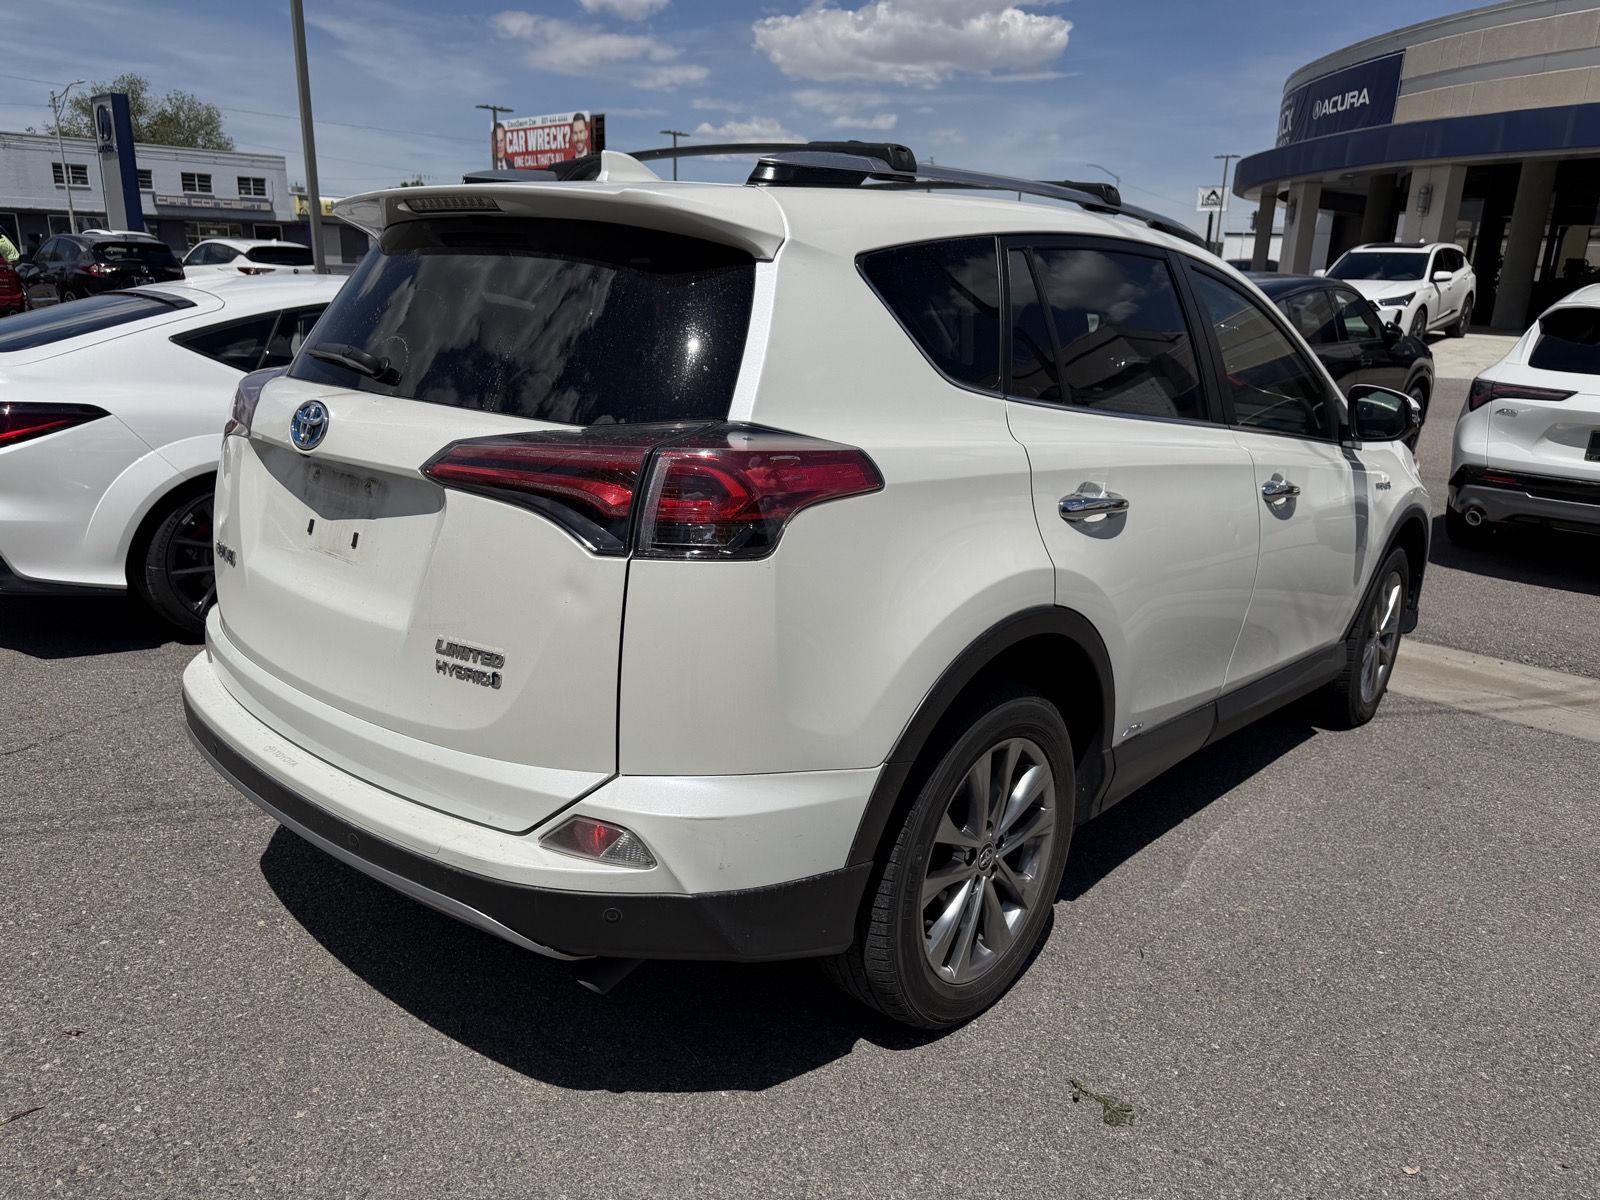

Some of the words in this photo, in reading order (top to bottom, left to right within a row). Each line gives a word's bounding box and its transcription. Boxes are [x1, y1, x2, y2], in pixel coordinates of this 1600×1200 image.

[1320, 88, 1370, 117] ACURA
[506, 130, 526, 153] CAR
[526, 125, 571, 152] WRECK?
[514, 156, 524, 168] ONE
[524, 155, 537, 167] CALL
[435, 638, 506, 669] LIMITED
[435, 658, 492, 687] HYBRID
[271, 750, 299, 767] TOYOTA
